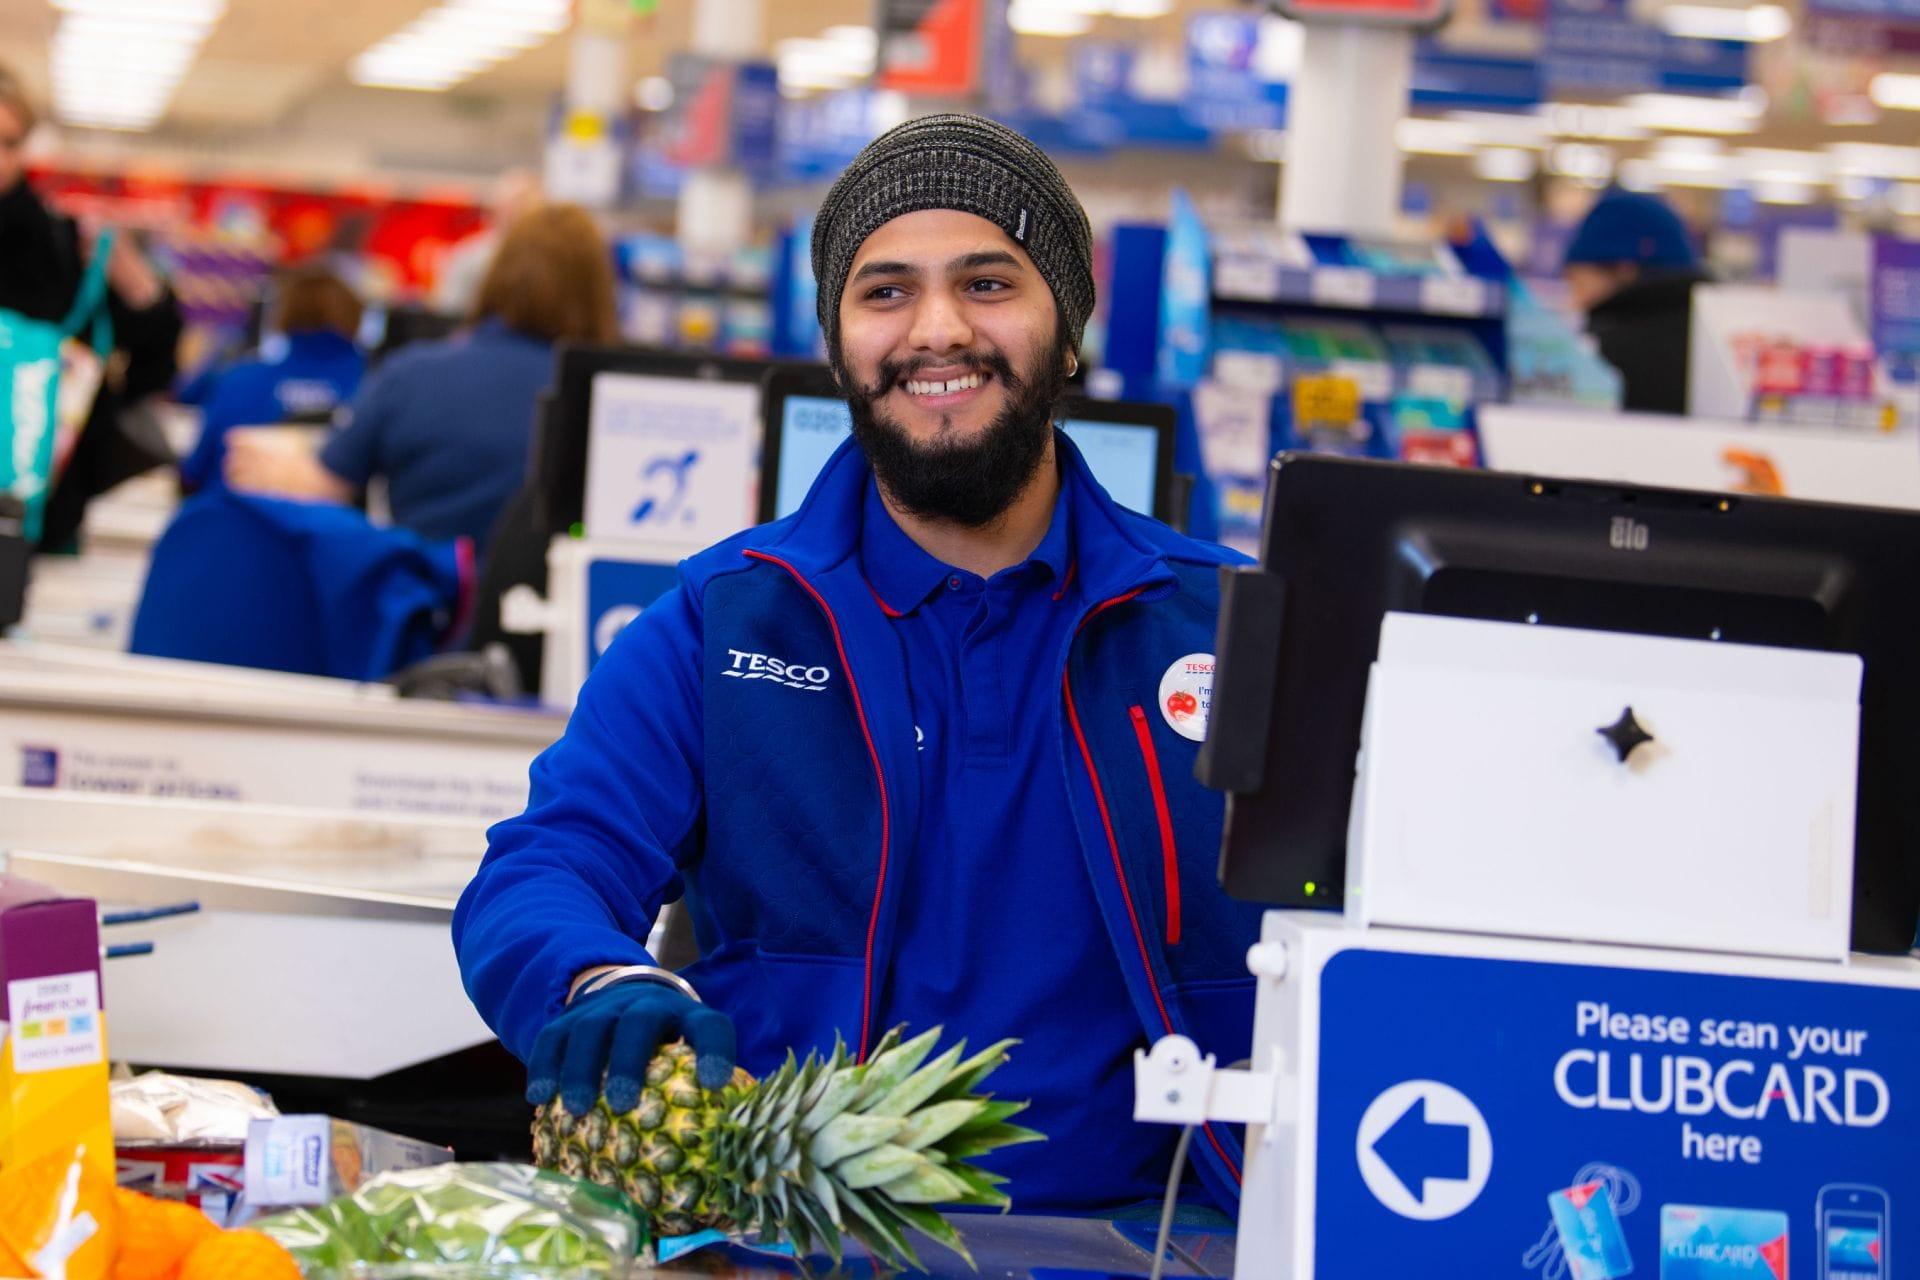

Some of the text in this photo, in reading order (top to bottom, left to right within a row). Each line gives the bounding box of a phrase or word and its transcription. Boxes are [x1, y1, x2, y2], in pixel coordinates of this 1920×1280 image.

[728, 648, 830, 684] TESCO
[1577, 1001, 1868, 1060] Please scan your
[1553, 1048, 1891, 1128] CLUBCARD
[1681, 1121, 1763, 1164] here
[1666, 1239, 1758, 1269] CLUBCARD
